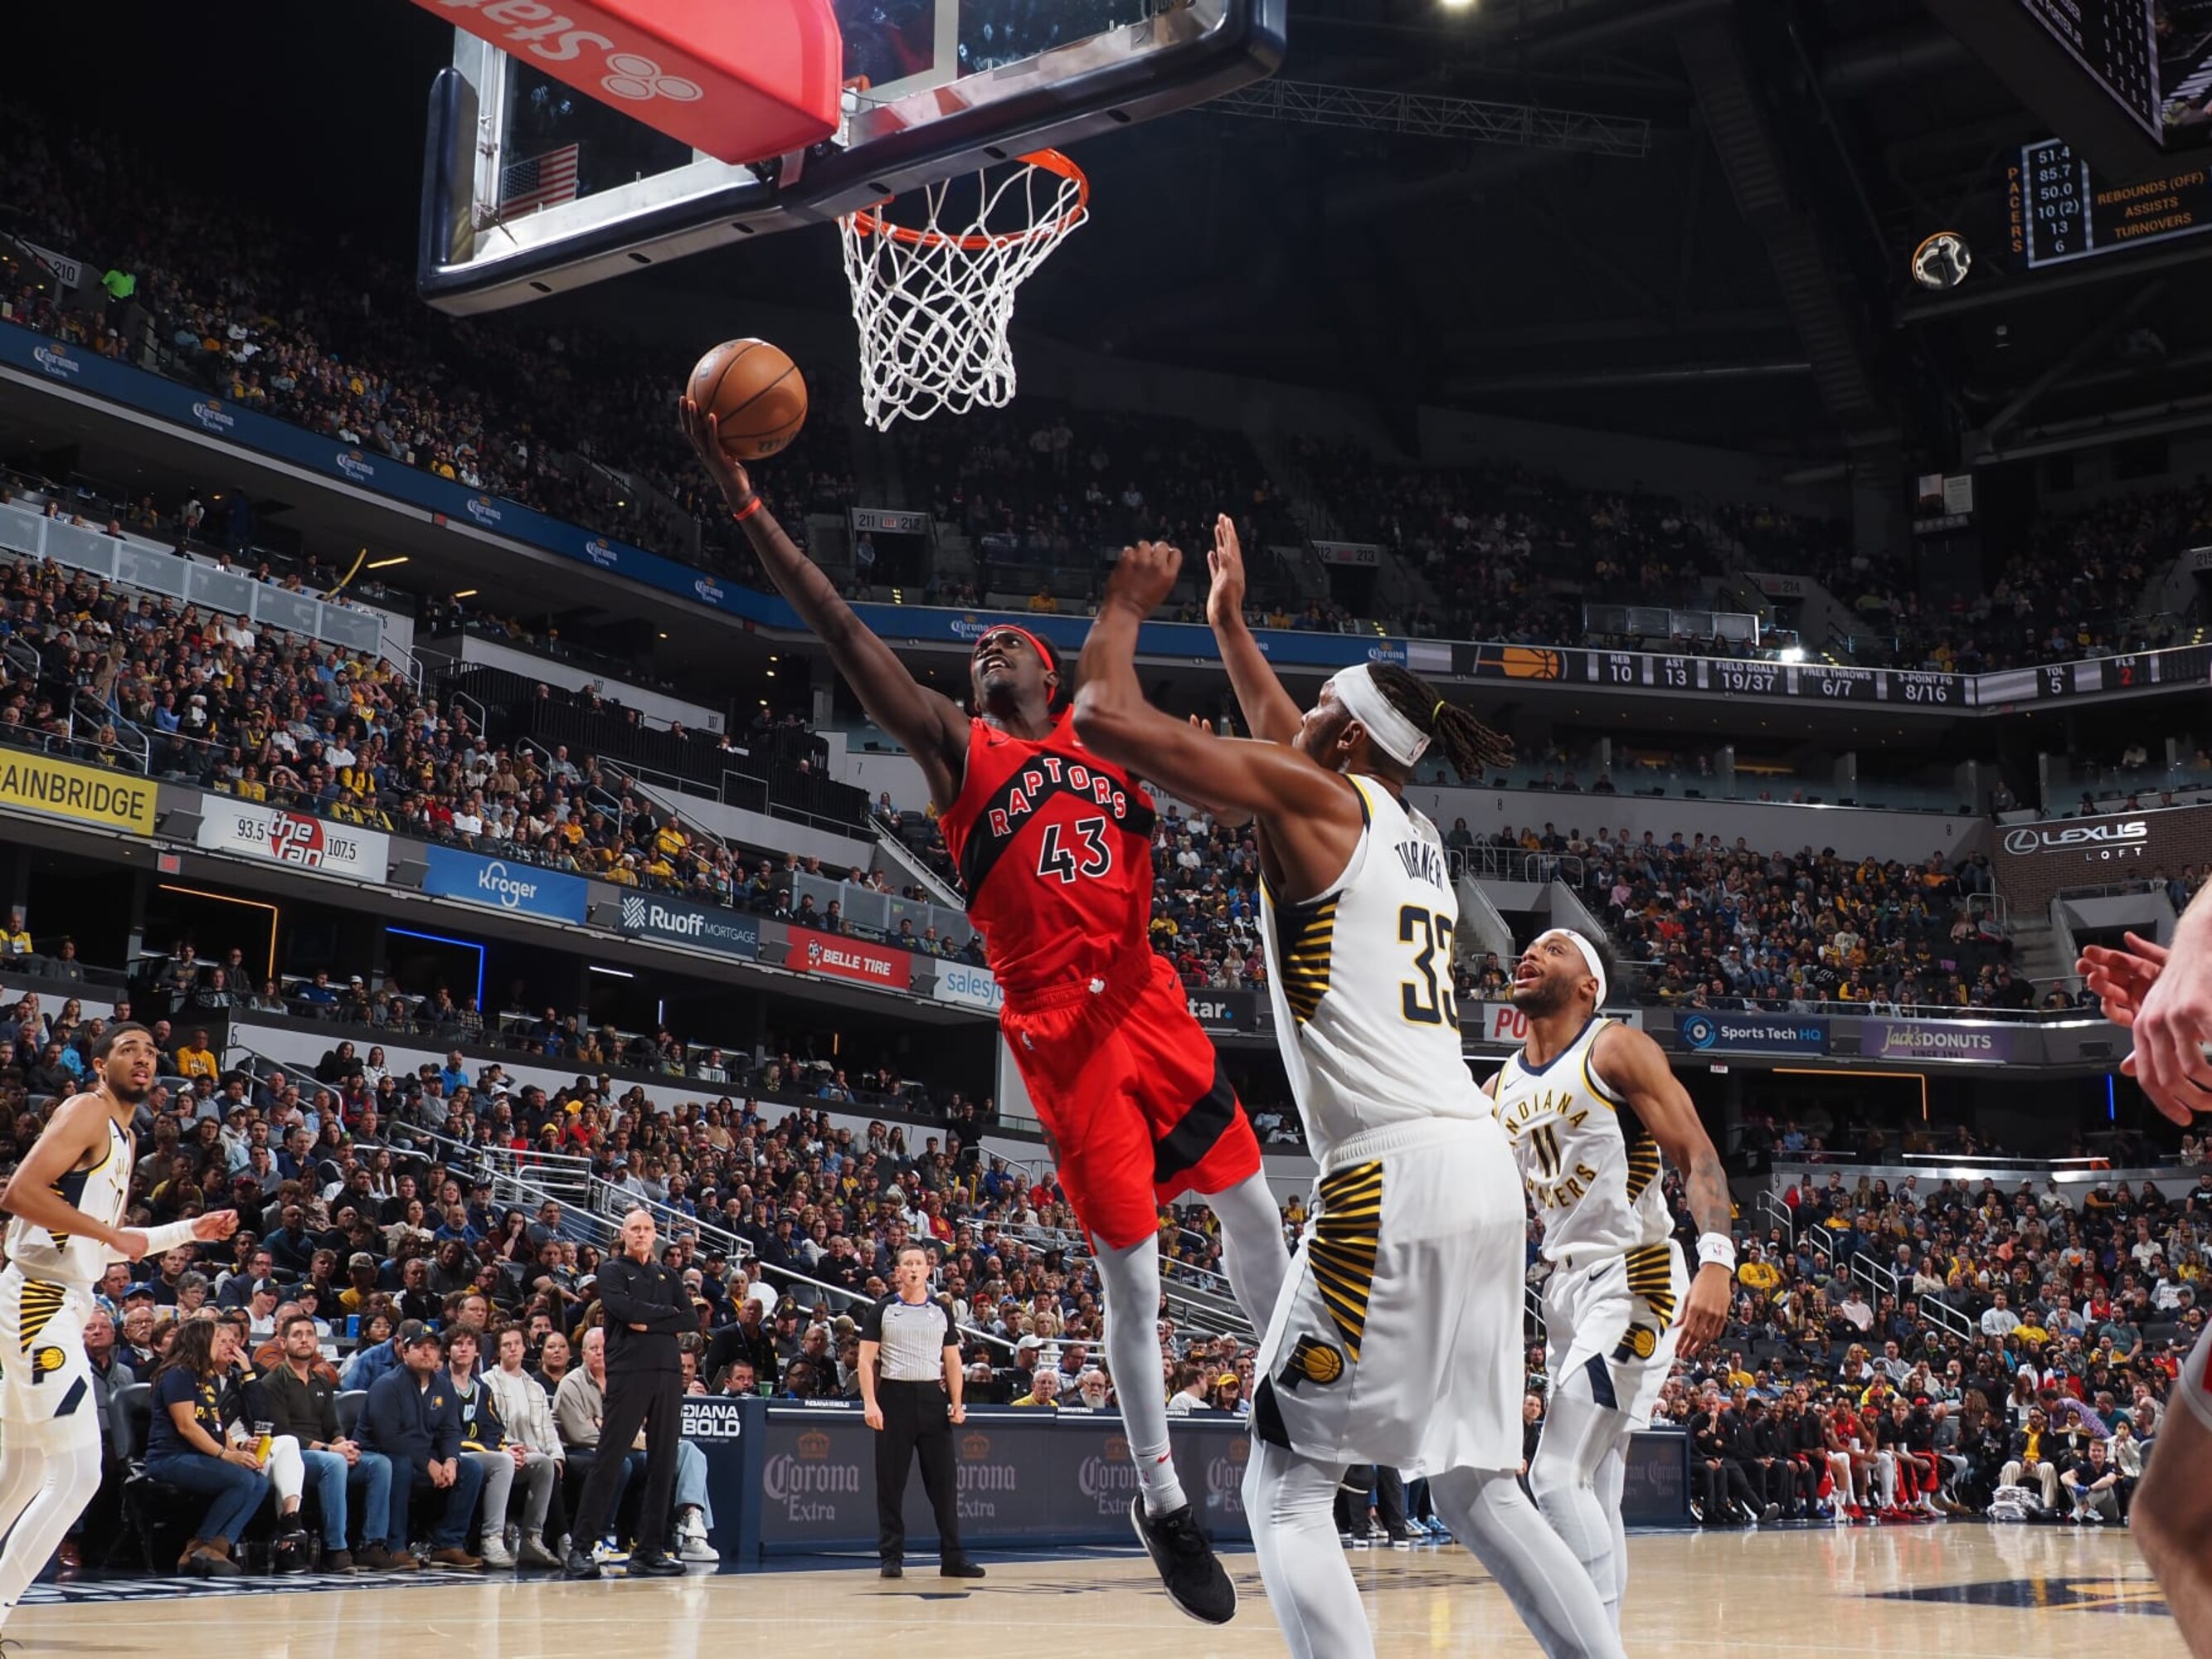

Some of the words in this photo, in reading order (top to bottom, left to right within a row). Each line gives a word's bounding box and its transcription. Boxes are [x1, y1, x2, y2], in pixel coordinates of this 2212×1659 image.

[438, 0, 615, 61] Sta
[2038, 145, 2071, 164] 51.4
[2039, 164, 2072, 182] 85.7
[2040, 182, 2073, 201] 50.0
[2097, 179, 2167, 206] REBOUNDS
[2169, 171, 2205, 191] (OFF)
[2007, 168, 2024, 253] PACERS
[2038, 204, 2056, 220] 10
[2059, 198, 2080, 217] (2)
[2123, 196, 2180, 218] ASSISTS
[2049, 221, 2069, 235] 13
[2114, 212, 2194, 239] TURNOVERS
[2054, 240, 2065, 252] 6
[53, 261, 75, 281] 210
[858, 514, 875, 528] 211
[901, 517, 921, 531] 212
[1356, 548, 1375, 562] 213
[1610, 654, 1631, 664] REB
[1665, 659, 1684, 669] AST
[1715, 662, 1744, 672] FIELD
[1746, 664, 1778, 674] GOALS
[1802, 667, 1827, 678] FREE
[1830, 669, 1872, 680] THROWS
[1898, 674, 1937, 684] 3-POINT
[1940, 676, 1953, 685] FG
[2045, 666, 2066, 678] TOL
[2116, 656, 2136, 669] FLS
[1611, 665, 1632, 682] 10
[1666, 669, 1687, 686] 13
[1723, 672, 1775, 692] 19/37
[1822, 679, 1853, 698] 6/7
[1905, 684, 1947, 702] 8/16
[2050, 677, 2063, 695] 5
[2121, 667, 2134, 686] 2
[0, 764, 146, 820] AINBRIDGE
[989, 757, 1126, 838] RAPTORS
[237, 819, 264, 840] 93.5
[328, 838, 357, 860] 107.5
[266, 810, 313, 842] the
[2042, 821, 2147, 844] LEXUS
[277, 835, 323, 867] fan
[1038, 816, 1111, 883] 43
[2086, 848, 2142, 861] LOFT
[1394, 840, 1444, 893] TURNER
[479, 862, 537, 907] Kroger
[649, 905, 704, 936] Ruoff
[705, 922, 756, 944] MORTGAGE
[823, 949, 860, 970] BELLE
[864, 958, 892, 975] TIRE
[231, 1024, 239, 1045] 6
[1493, 1009, 1528, 1039] PO
[1721, 1026, 1765, 1040] Sports
[1766, 1028, 1796, 1039] Tech
[1799, 1029, 1821, 1041] HQ
[1881, 1024, 1923, 1053] Jack's
[1923, 1033, 1992, 1048] DONUTS
[1530, 1123, 1562, 1179] 11
[681, 1404, 739, 1419] DIANA
[682, 1418, 741, 1437] BOLD
[763, 1453, 859, 1500] Corona
[956, 1462, 1016, 1491] orona
[1079, 1455, 1140, 1496] Coron
[788, 1494, 835, 1521] Extra
[956, 1493, 995, 1519] Extra
